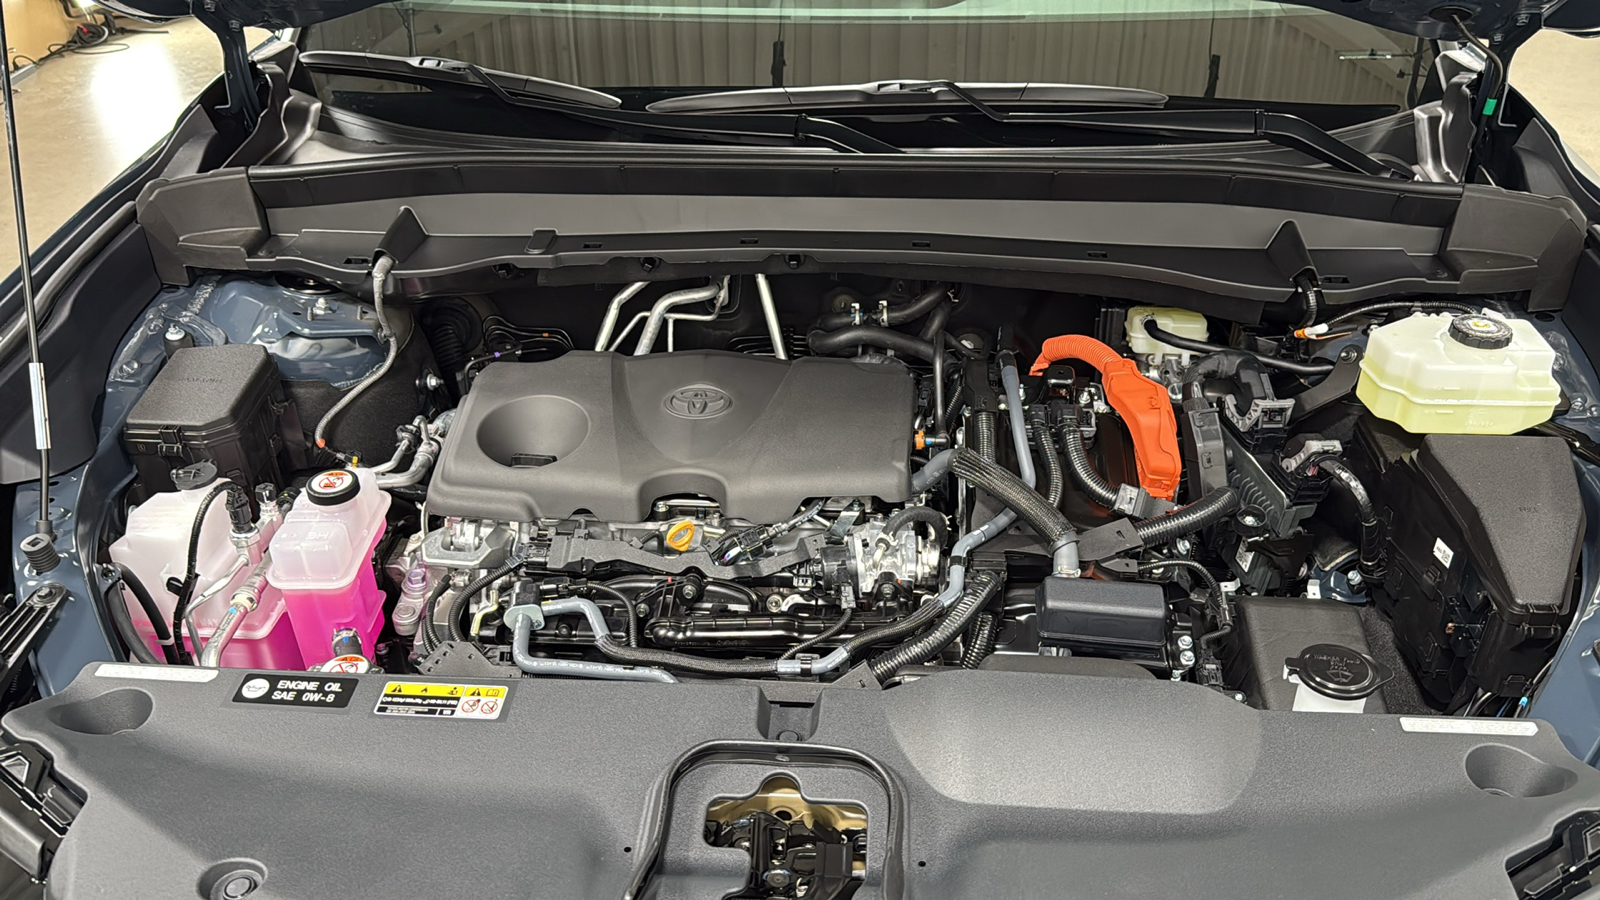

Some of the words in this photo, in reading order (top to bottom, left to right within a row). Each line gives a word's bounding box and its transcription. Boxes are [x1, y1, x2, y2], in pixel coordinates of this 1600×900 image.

[277, 680, 320, 691] ENGINE
[324, 682, 343, 692] OIL
[271, 690, 297, 701] SAE
[301, 692, 335, 703] 0W-8
